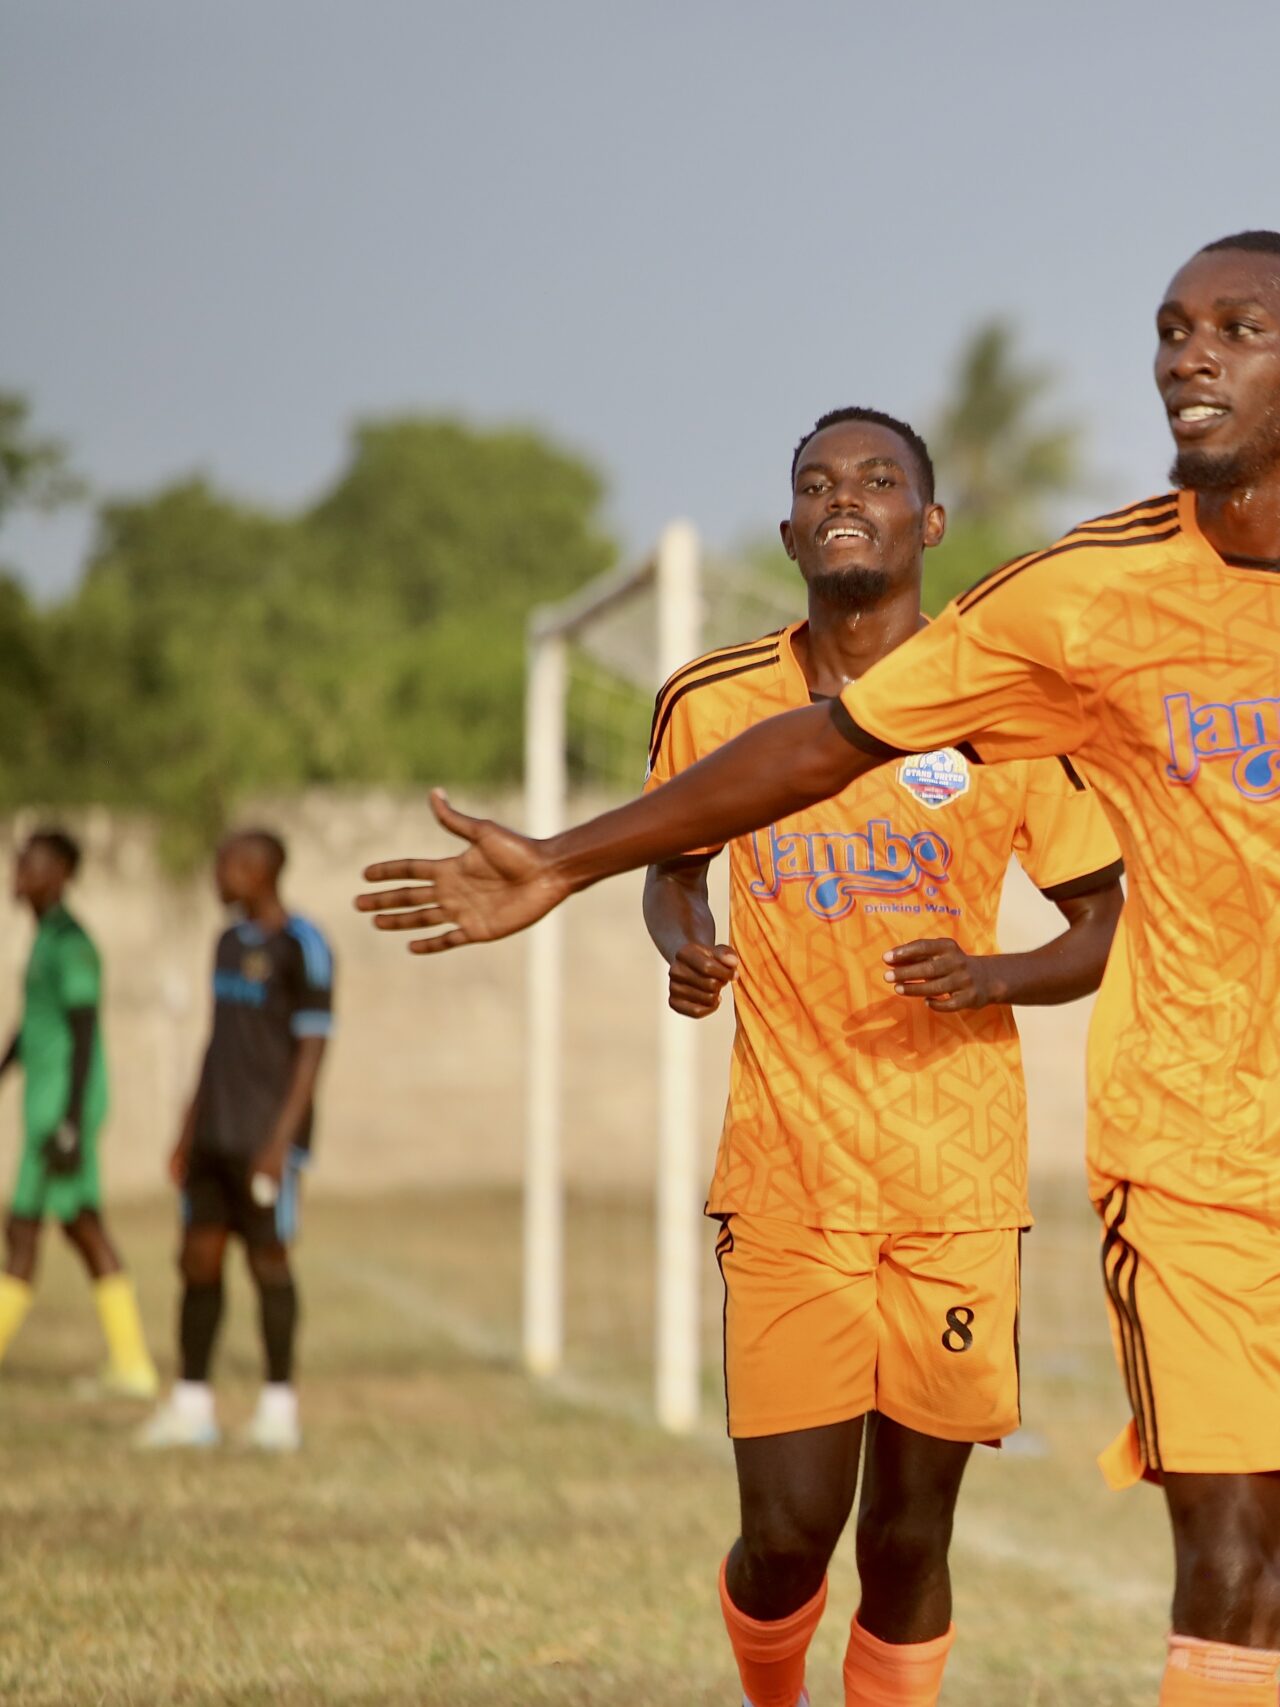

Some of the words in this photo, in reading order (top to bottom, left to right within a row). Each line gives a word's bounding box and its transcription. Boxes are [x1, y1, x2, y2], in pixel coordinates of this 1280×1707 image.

[905, 768, 932, 780] STAND
[934, 771, 964, 783] UNITED
[751, 820, 951, 921] Jambo
[865, 903, 921, 914] Drinking
[925, 903, 961, 917] Water
[942, 1306, 975, 1353] 8
